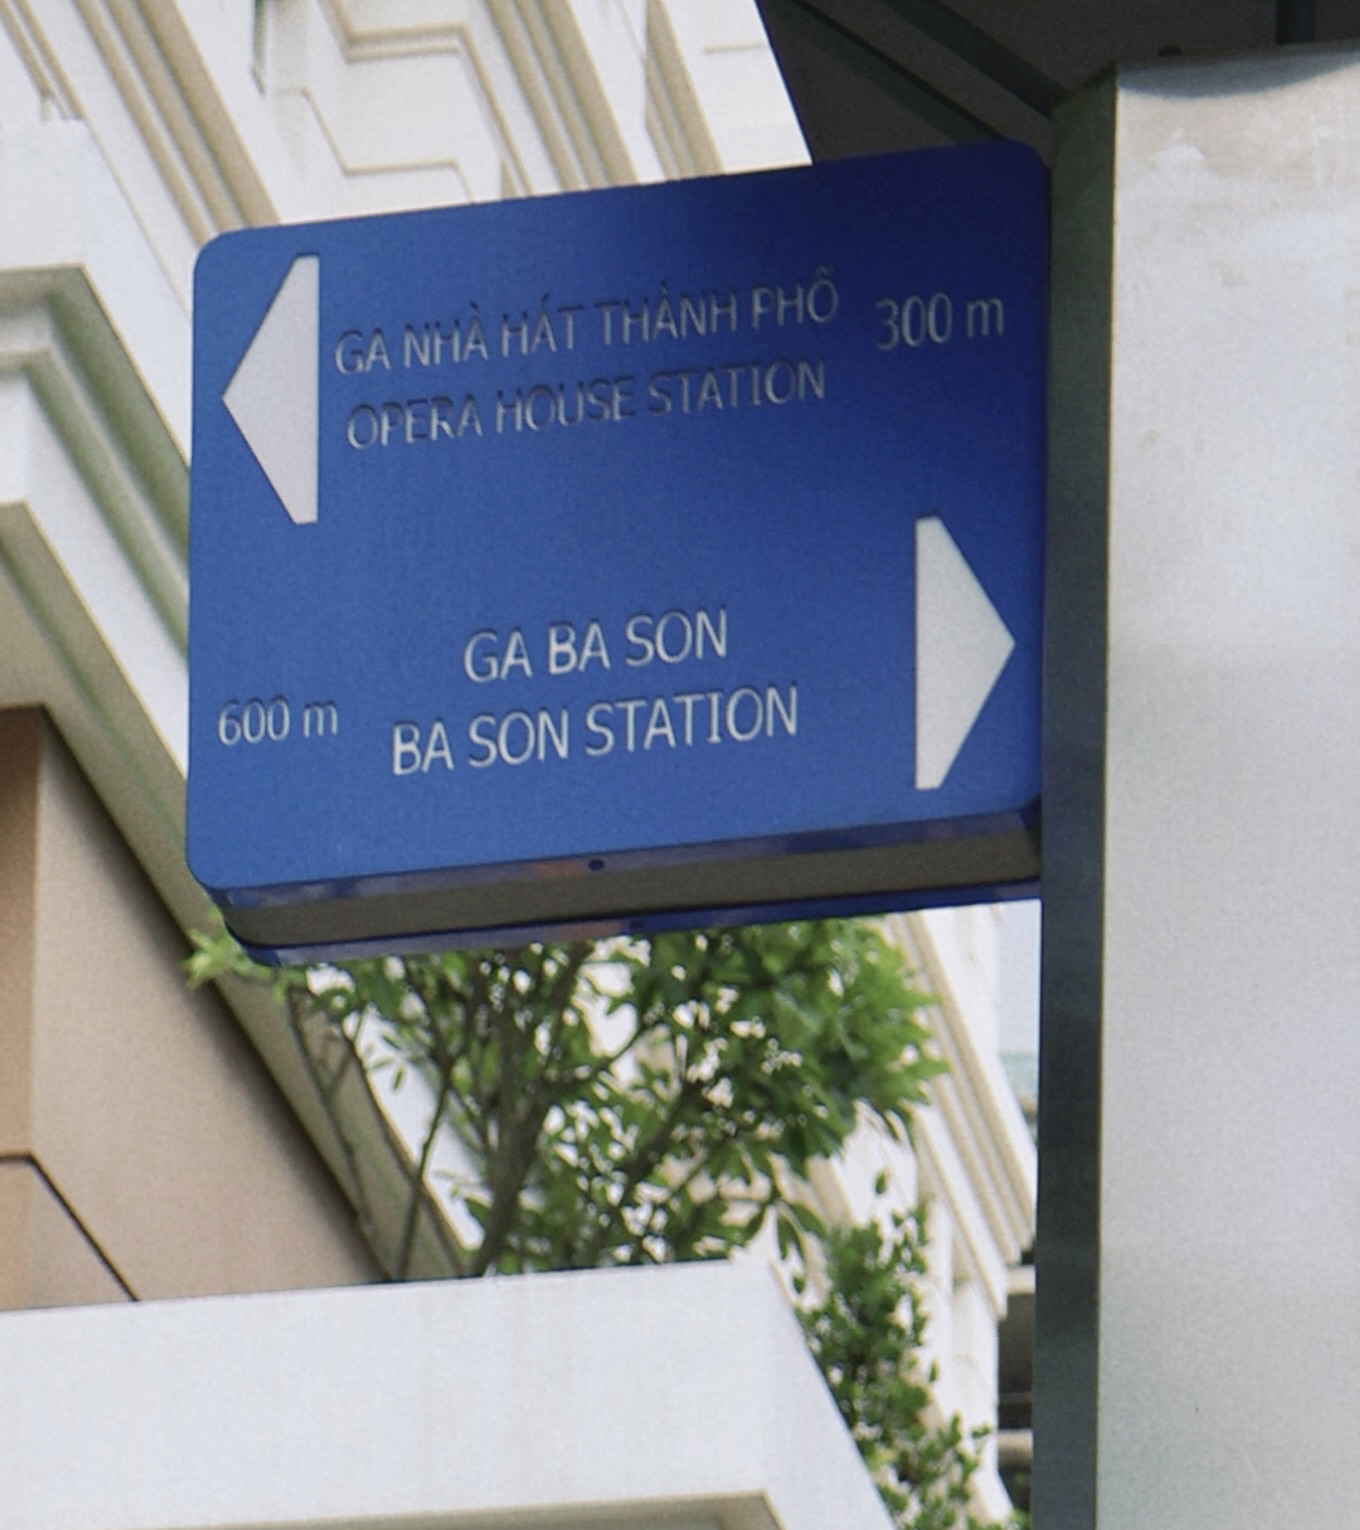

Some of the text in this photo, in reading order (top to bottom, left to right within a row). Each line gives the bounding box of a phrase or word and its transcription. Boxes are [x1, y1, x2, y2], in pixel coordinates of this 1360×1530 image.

[334, 327, 391, 375] GA
[403, 302, 489, 369] NHÀ
[501, 292, 584, 357] HÁT
[594, 280, 738, 346] THÀNH
[876, 292, 1005, 351] 300 m
[346, 354, 826, 450] OPERA HOUSE STATION
[463, 606, 728, 684] GA BA SON
[217, 695, 339, 747] 600 m
[391, 681, 798, 776] BA SON STATION
